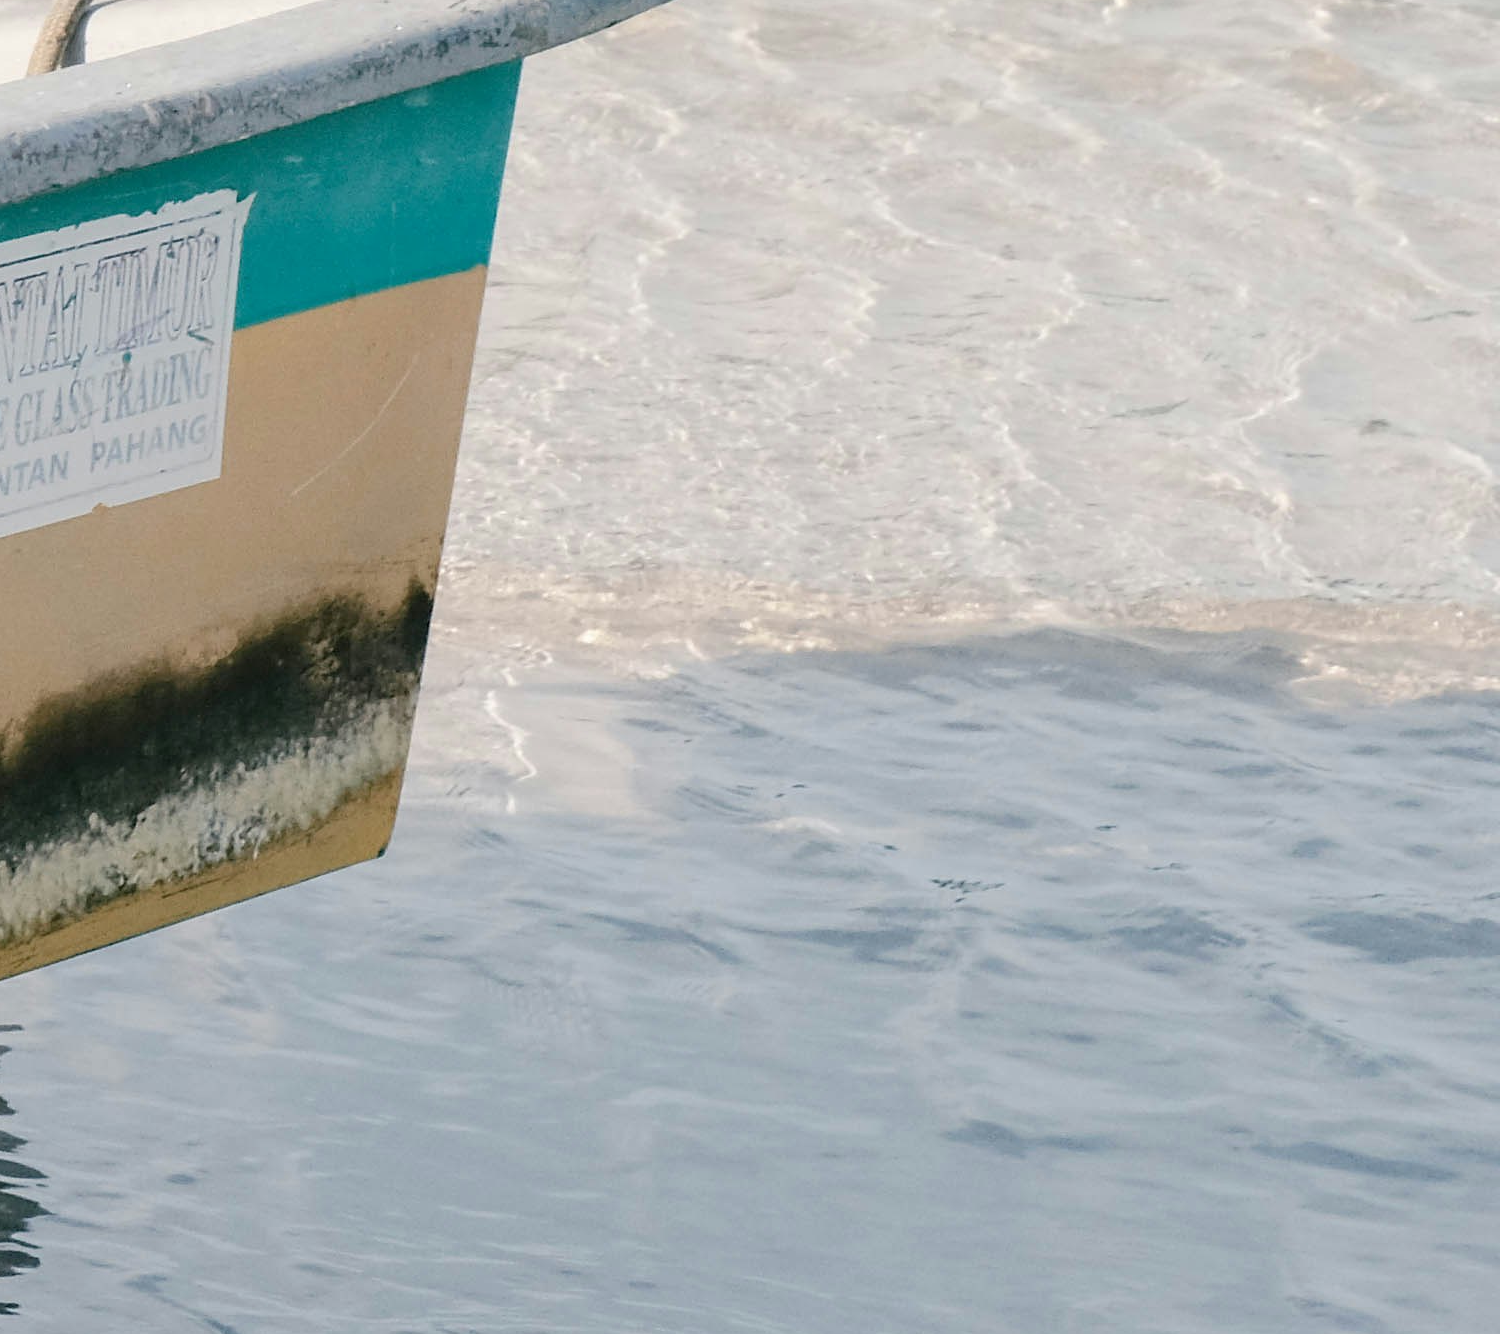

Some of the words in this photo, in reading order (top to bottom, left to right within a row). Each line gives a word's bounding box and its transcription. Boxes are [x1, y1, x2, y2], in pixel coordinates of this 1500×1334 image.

[88, 229, 220, 358] TIMUR
[14, 374, 96, 447] GLASS
[100, 346, 214, 425] TRADING
[89, 415, 208, 473] PAHANG
